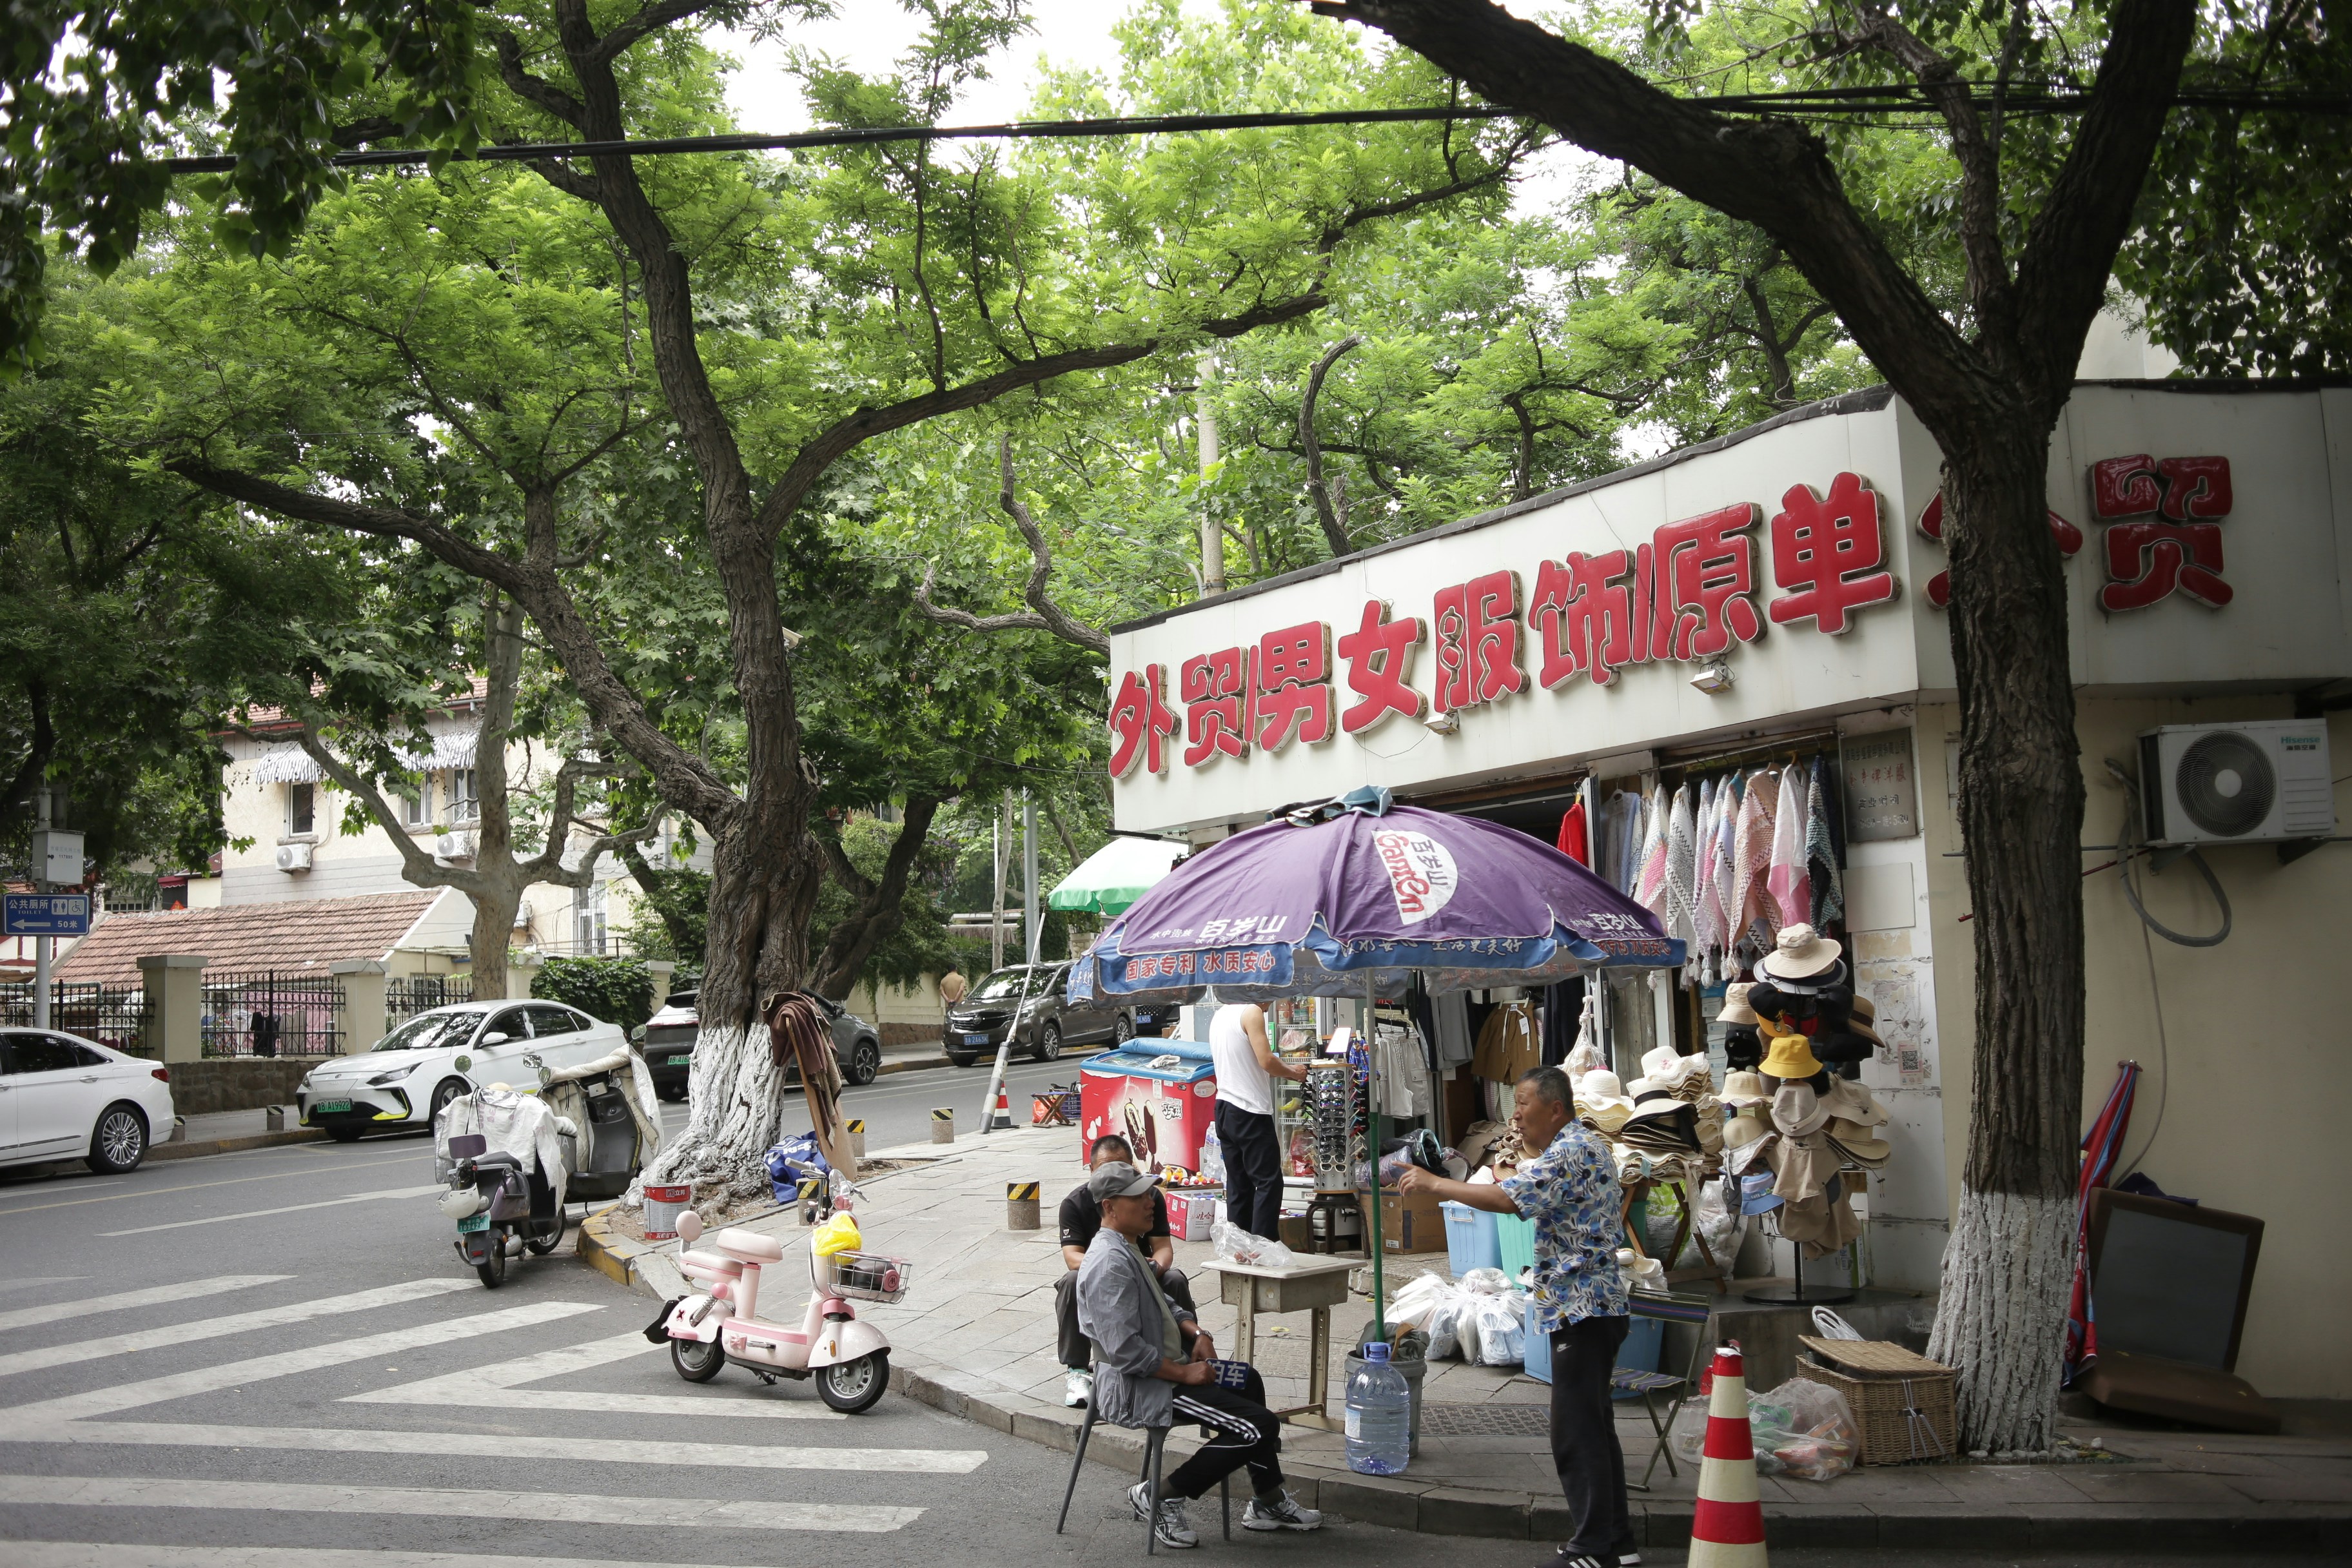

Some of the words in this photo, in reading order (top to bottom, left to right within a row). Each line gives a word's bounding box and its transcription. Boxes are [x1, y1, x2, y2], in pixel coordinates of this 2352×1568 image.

[1108, 471, 1902, 779] 外贸男女服饰原单
[1411, 839, 1449, 886] 百岁山
[9, 899, 48, 910] 公共厕所
[57, 920, 78, 929] 50米
[1150, 928, 1194, 940] 水中贵族
[1199, 915, 1288, 939] 百岁山
[1432, 938, 1523, 956] 生活更美好
[1126, 952, 1197, 982] 国家专利
[1203, 949, 1276, 974] 水质安心
[1195, 1211, 1215, 1220] 娃哈
